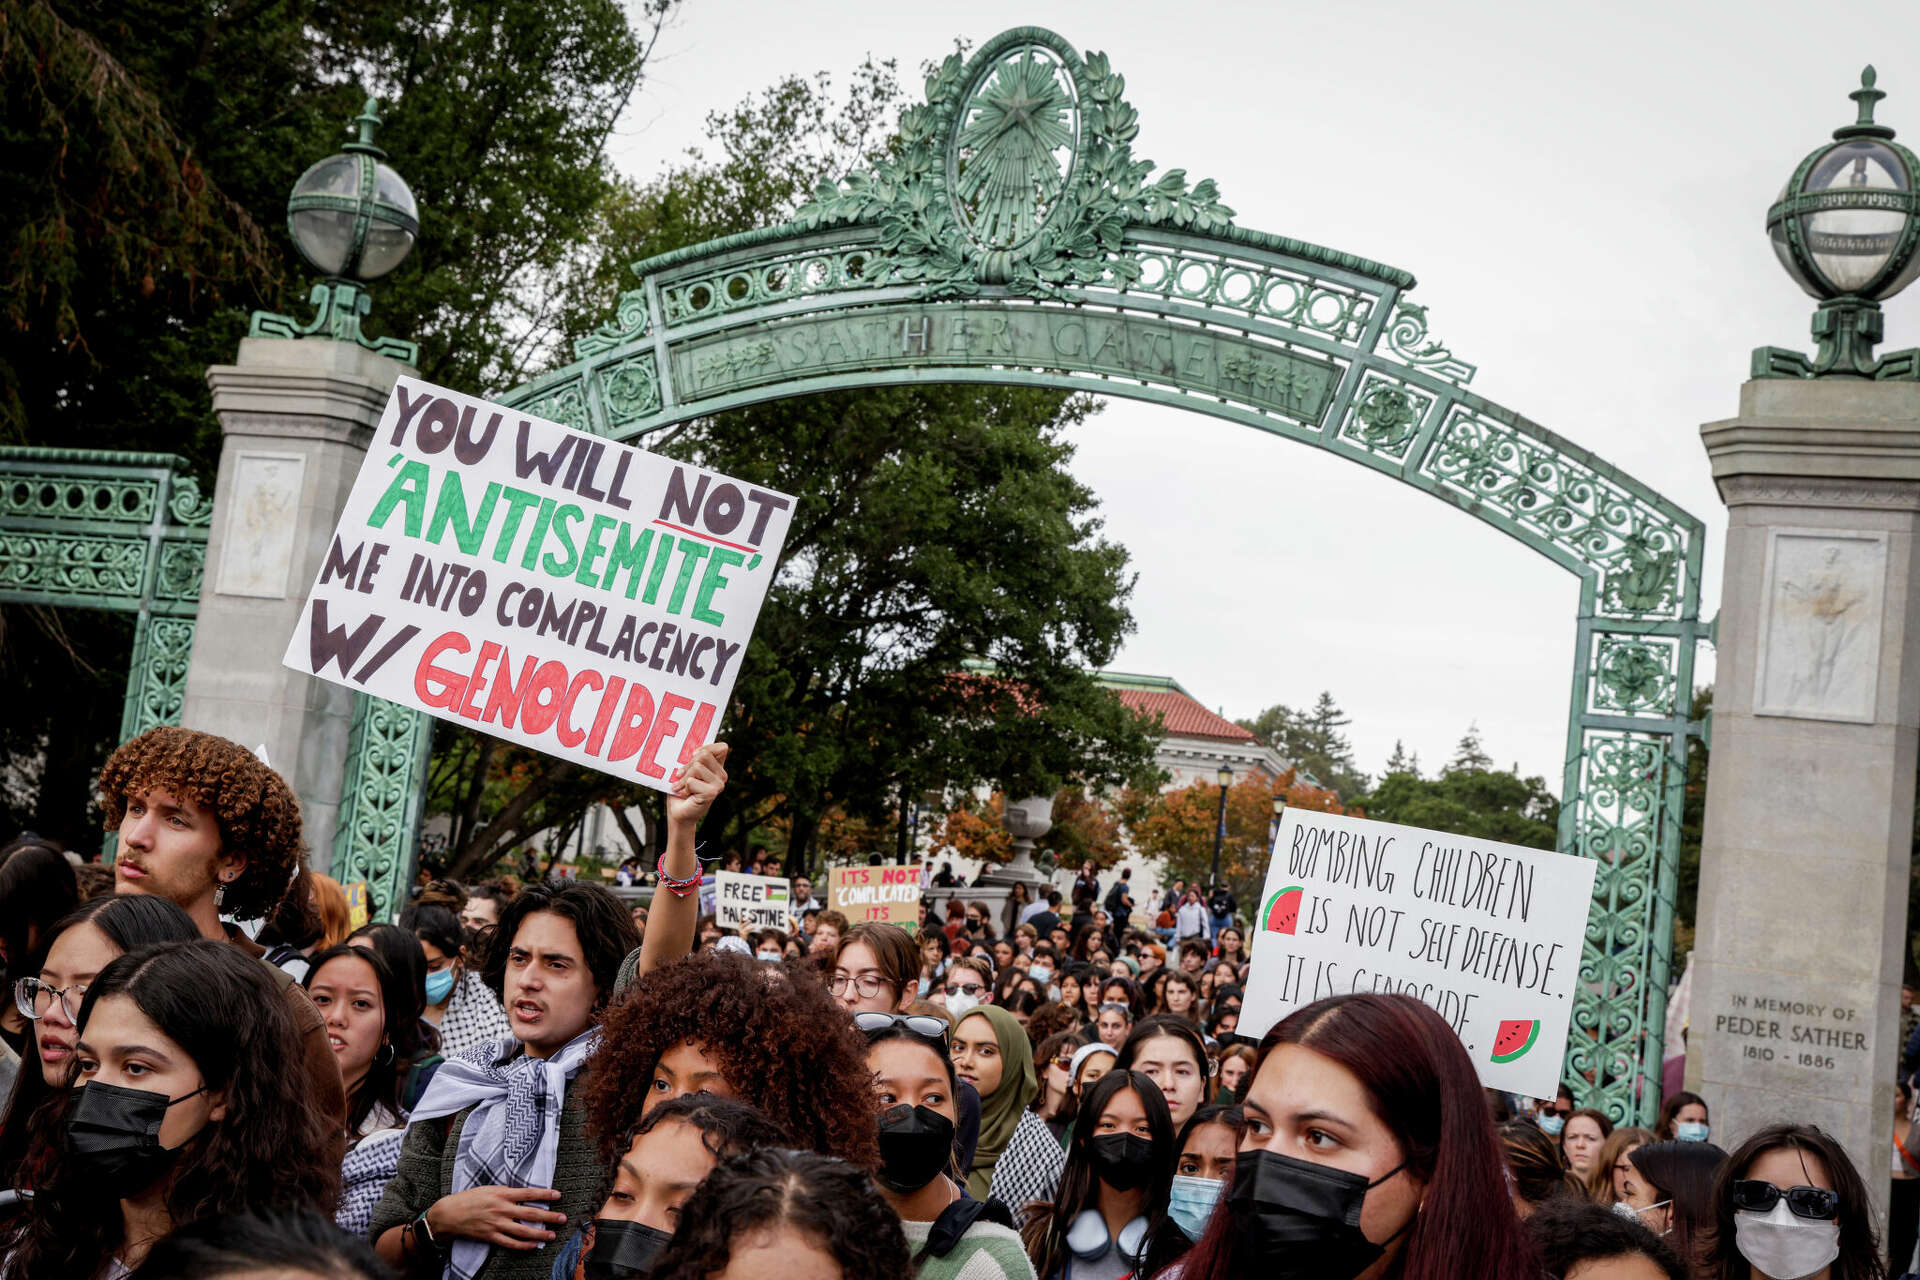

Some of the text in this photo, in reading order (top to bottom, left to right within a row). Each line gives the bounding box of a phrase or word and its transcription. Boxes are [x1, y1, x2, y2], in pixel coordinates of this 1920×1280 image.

[790, 316, 1214, 376] SATHER GATE
[390, 385, 789, 546] YOU WILL NOT
[319, 534, 740, 686] ME INTO COMPLACENCY
[310, 599, 716, 783] W/ GENOCIDE!
[724, 882, 763, 903] FREE
[841, 868, 920, 885] ITS NOT
[1288, 824, 1534, 923] BOMBING CHILDREN
[722, 906, 785, 928] PALESTINE
[866, 905, 890, 921] ITS
[1305, 896, 1332, 935] IS
[1345, 904, 1406, 952] NOT
[1409, 918, 1461, 970] SELF
[1280, 954, 1338, 1005] IT IS
[1731, 994, 1856, 1021] IN MEMORY OF
[1715, 1015, 1869, 1051] PEDER SATHER
[1743, 1045, 1775, 1061] 1810
[1798, 1053, 1835, 1070] 1886
